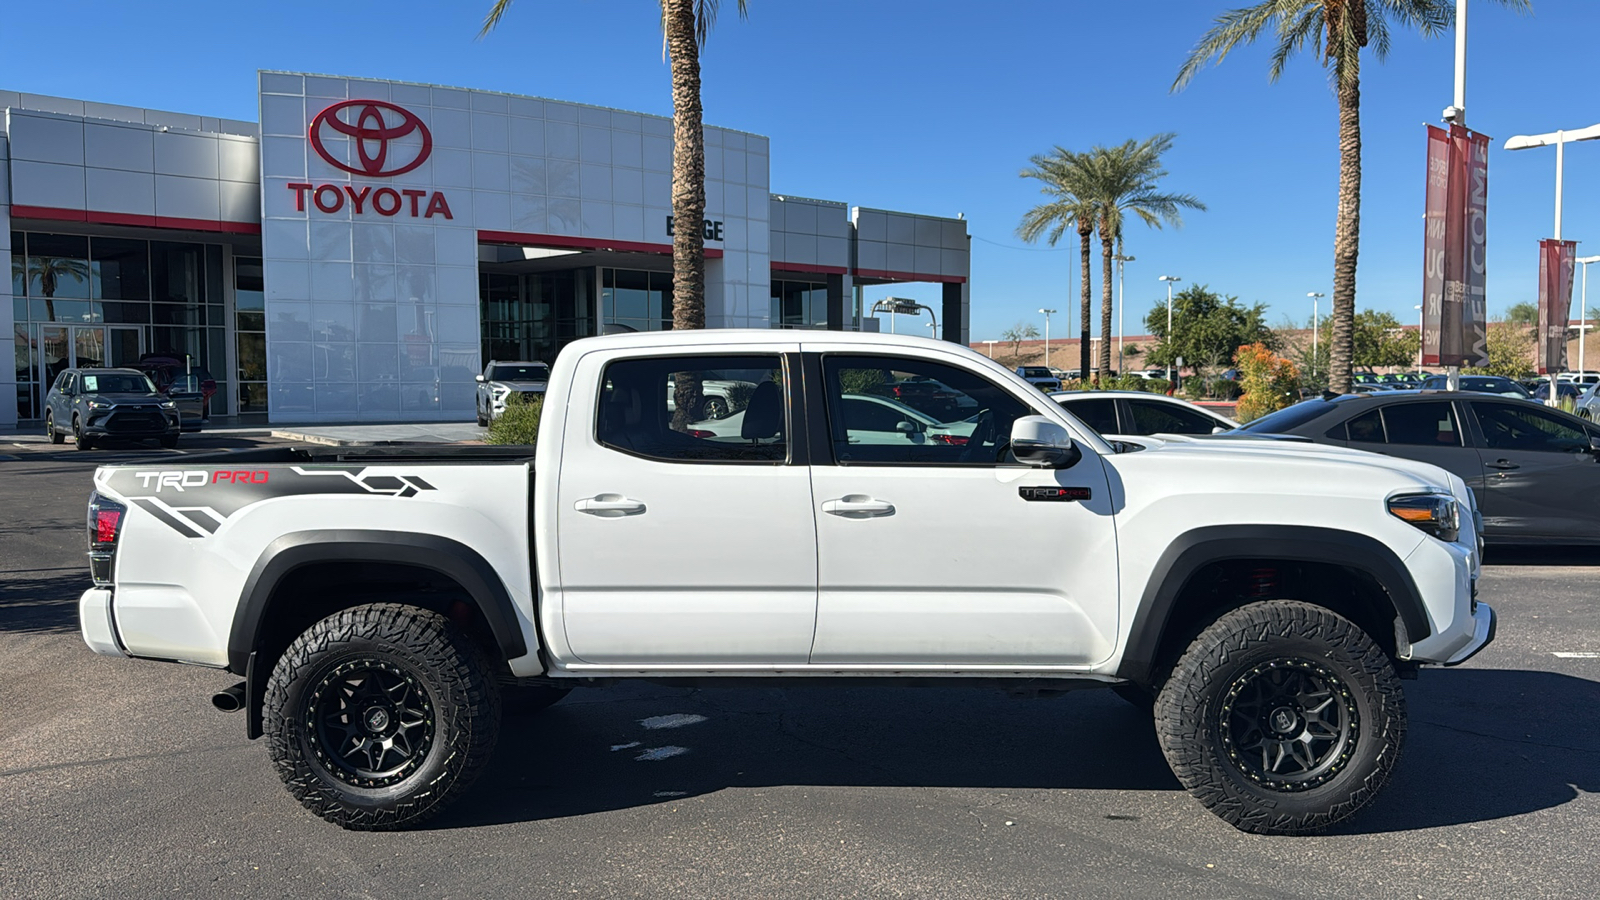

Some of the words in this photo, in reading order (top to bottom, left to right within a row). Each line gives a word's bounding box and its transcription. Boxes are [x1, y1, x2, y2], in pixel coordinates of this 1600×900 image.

[287, 183, 453, 219] TOYOTA
[135, 470, 209, 492] TRD
[212, 470, 269, 484] PRO
[1021, 488, 1059, 498] TRD
